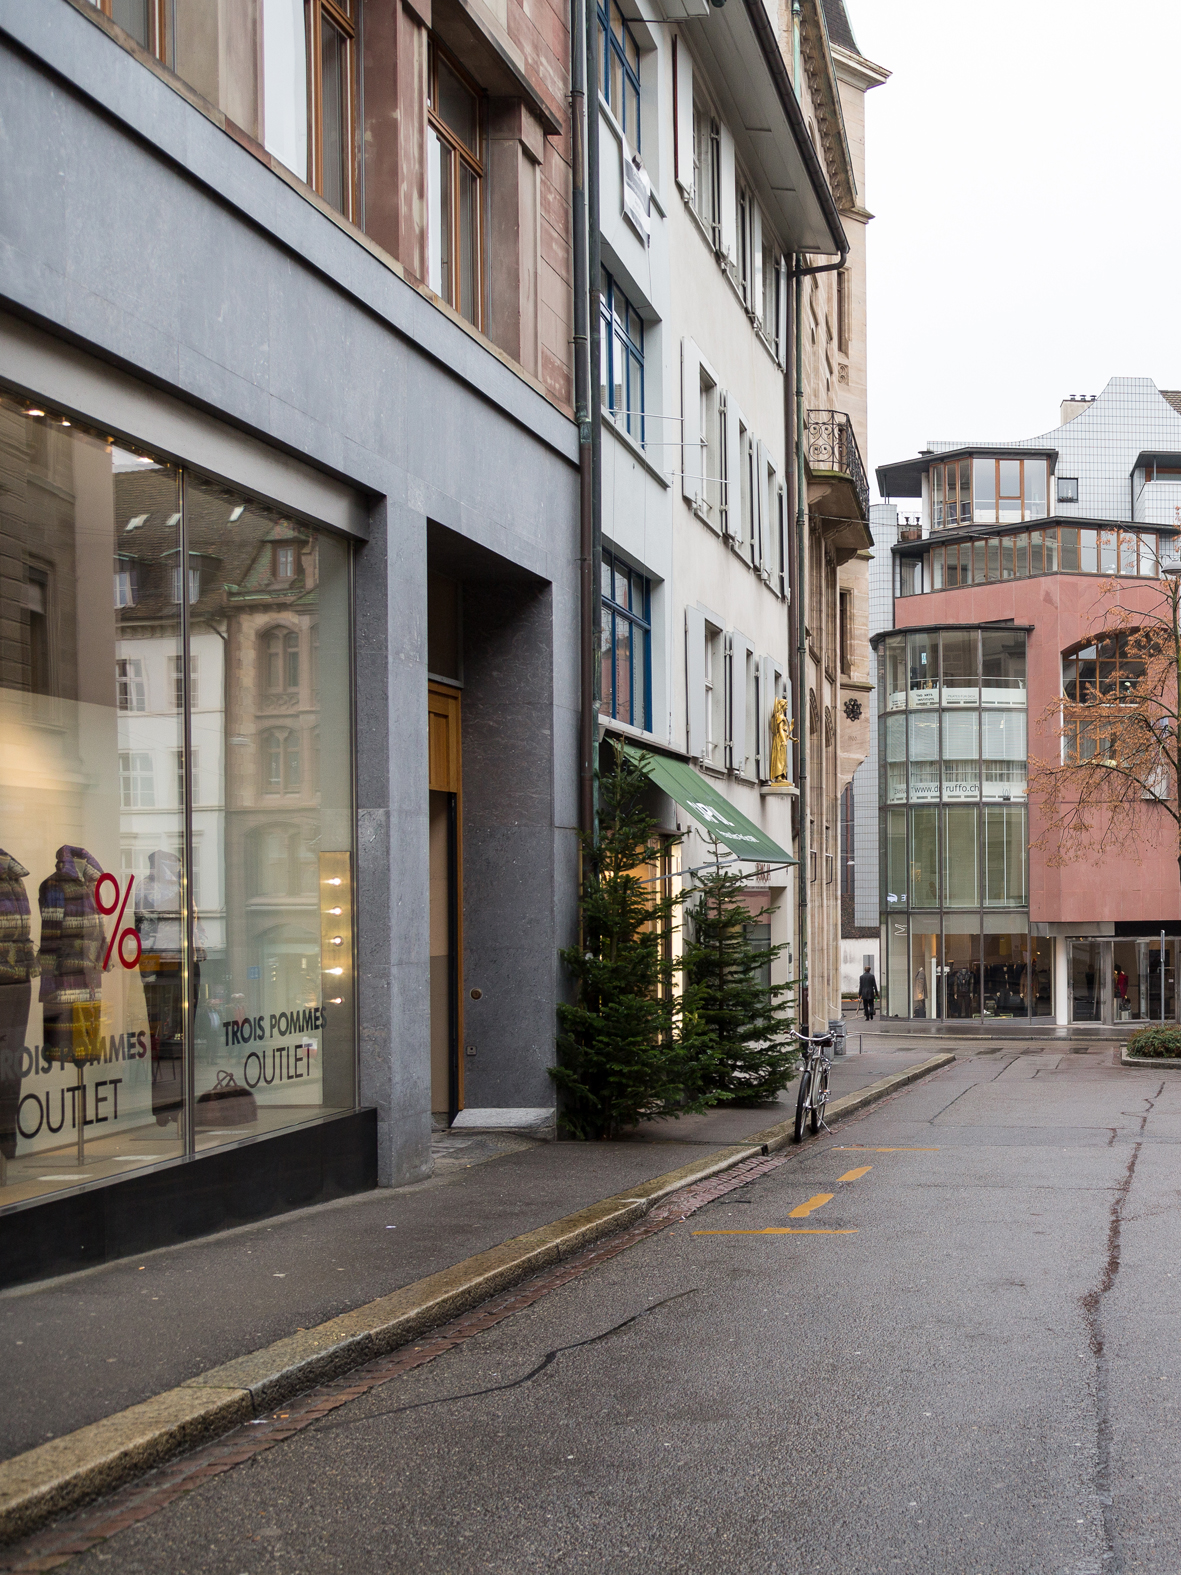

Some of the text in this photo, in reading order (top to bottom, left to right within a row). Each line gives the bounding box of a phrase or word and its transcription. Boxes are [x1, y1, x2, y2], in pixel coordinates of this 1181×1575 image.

[914, 783, 980, 794] www.d-ruffo.ch
[95, 873, 142, 970] %
[223, 1006, 327, 1047] TROIS POMMES
[0, 1043, 53, 1081] ROIS
[244, 1043, 313, 1089] OUTLET
[17, 1078, 122, 1139] OUTLET
